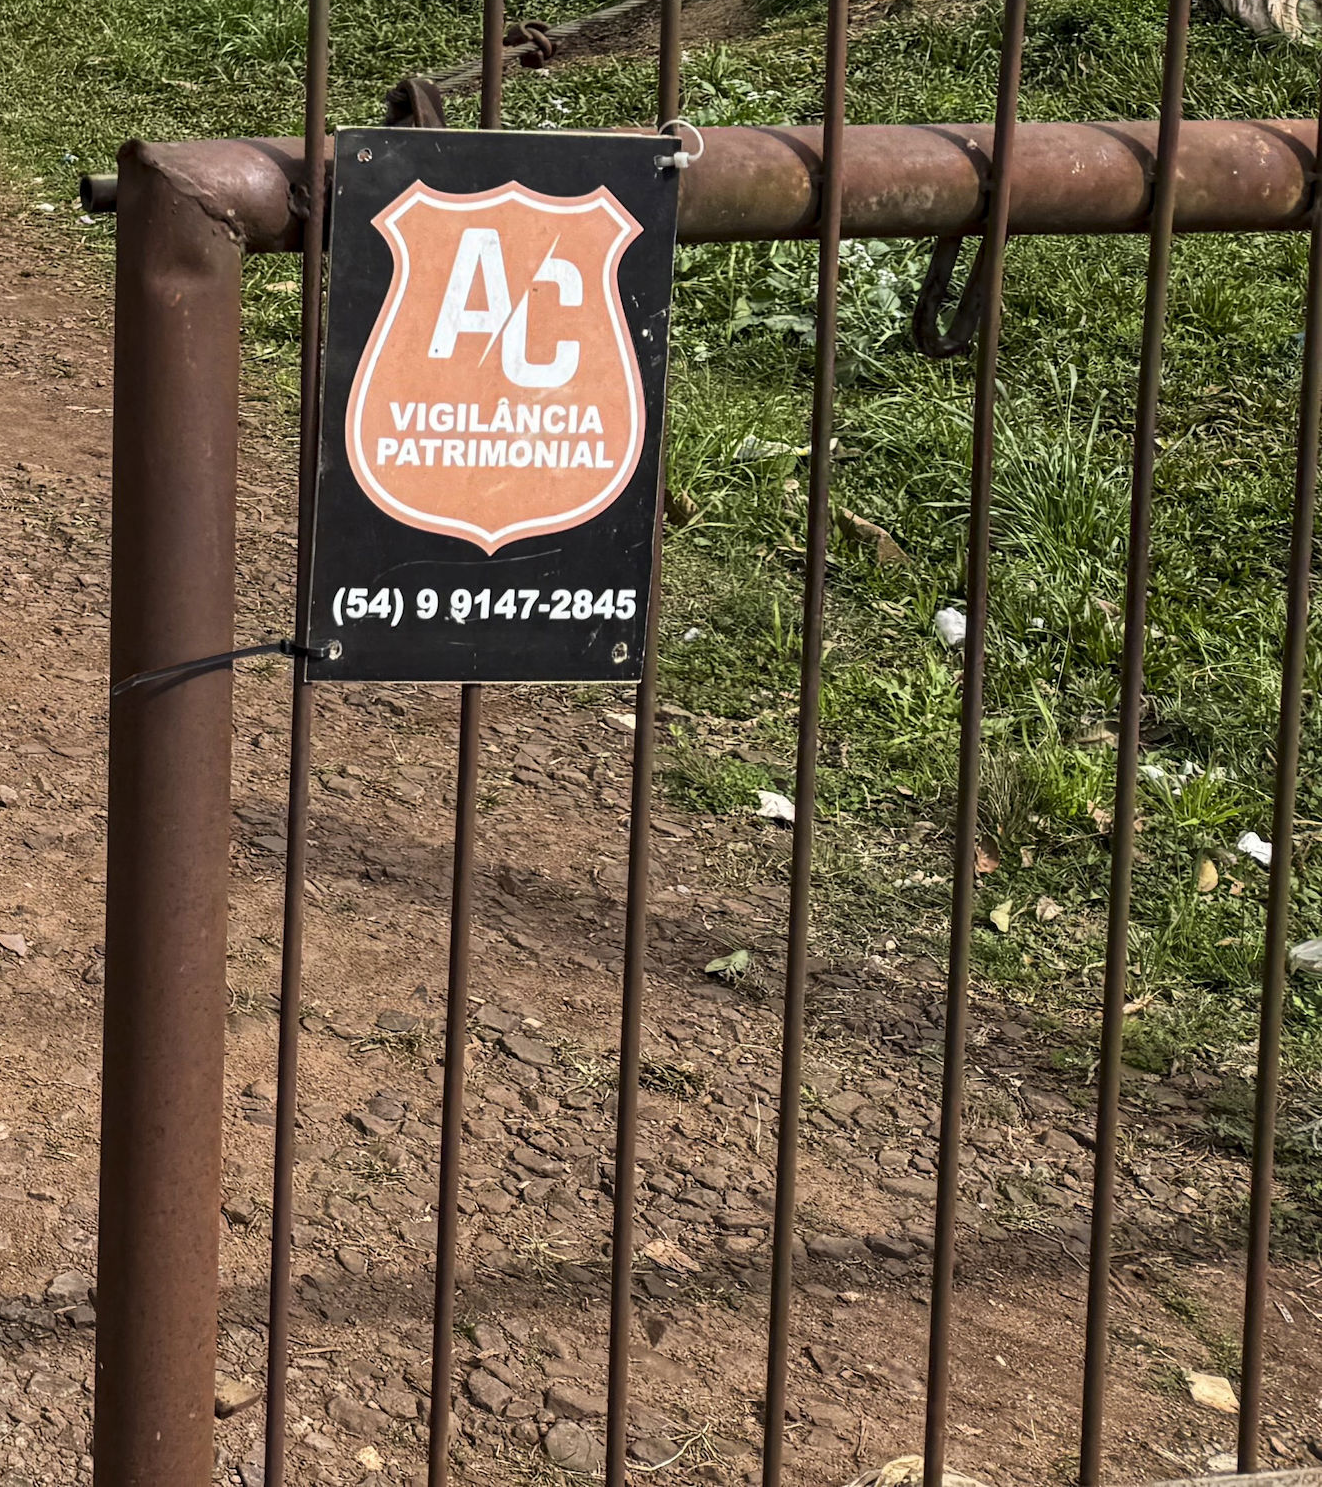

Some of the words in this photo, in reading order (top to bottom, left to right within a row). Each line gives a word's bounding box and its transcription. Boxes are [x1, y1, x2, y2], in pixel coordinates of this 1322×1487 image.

[389, 398, 604, 434] VIGILÂNCIA
[375, 438, 614, 469] PATRIMONIAL
[332, 586, 404, 625] (54)
[416, 588, 439, 620] 9
[454, 587, 637, 620] 9147-2845
